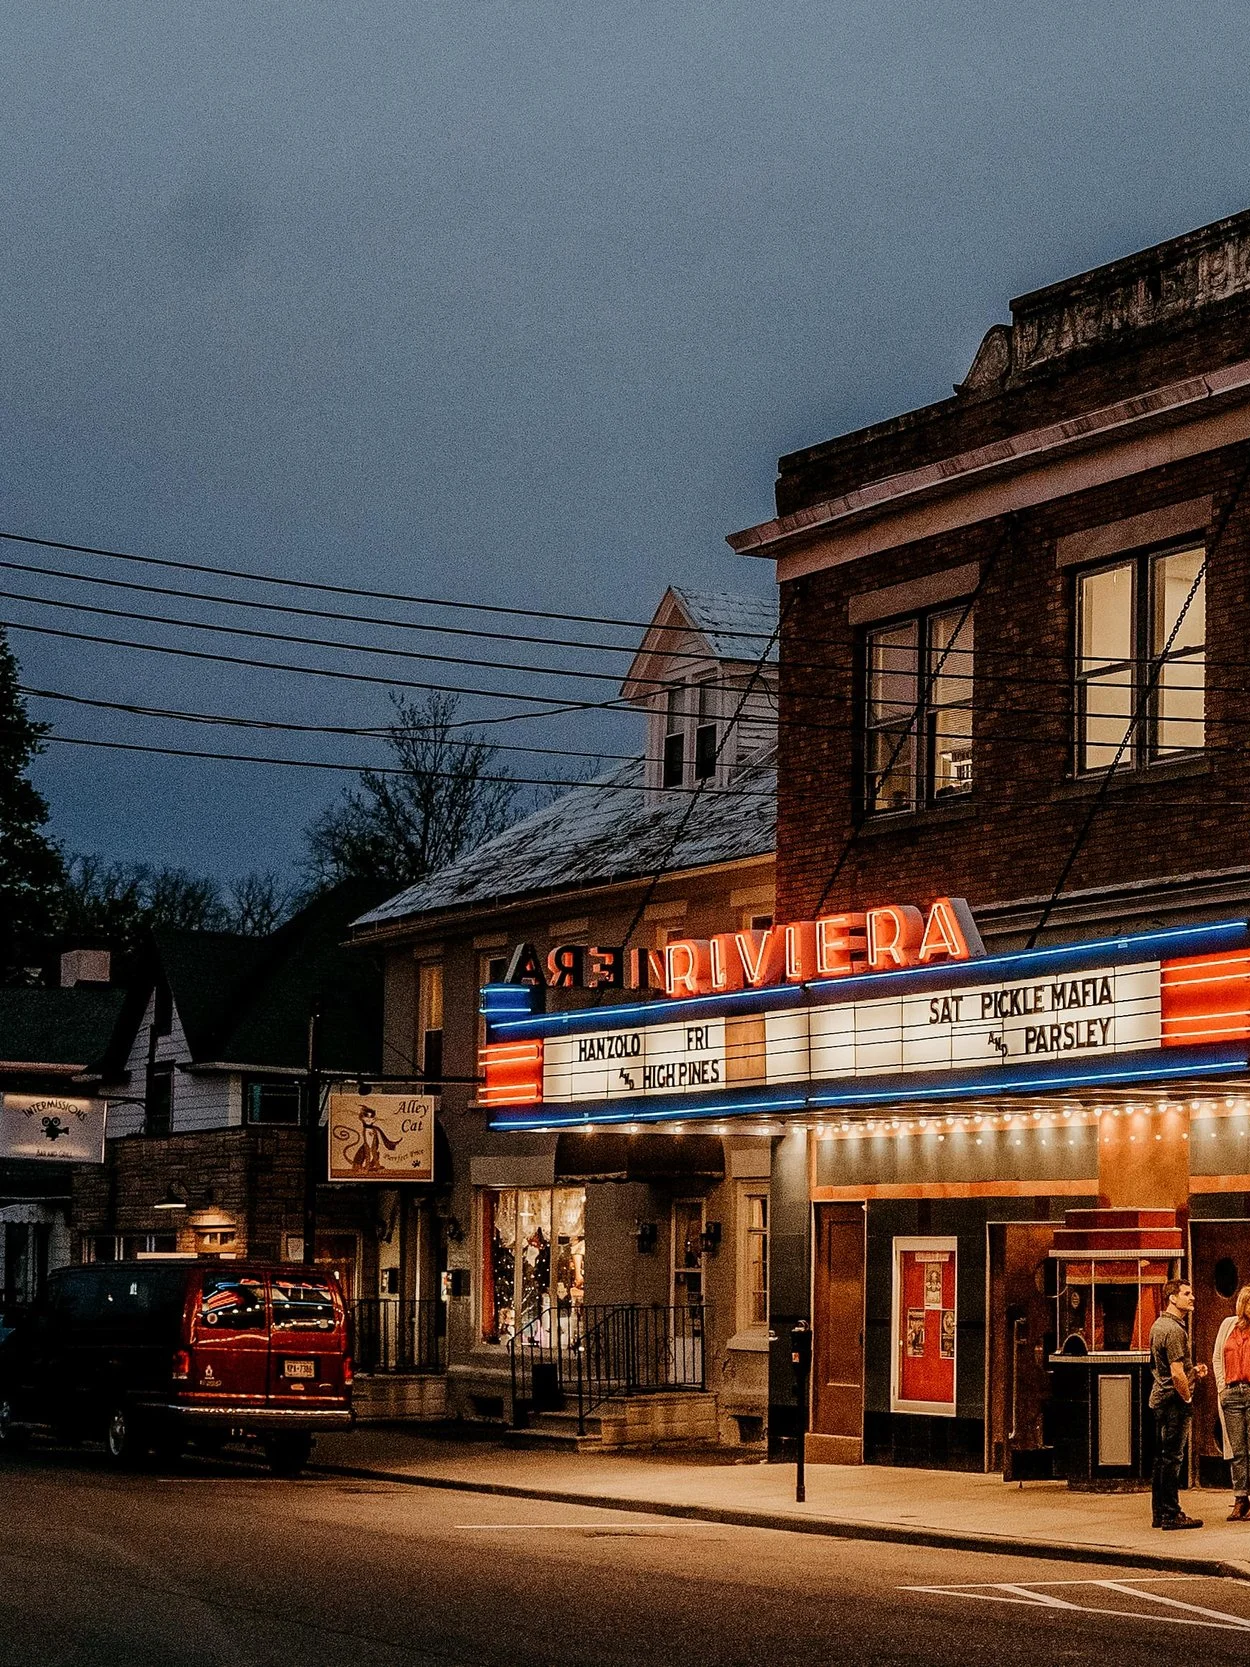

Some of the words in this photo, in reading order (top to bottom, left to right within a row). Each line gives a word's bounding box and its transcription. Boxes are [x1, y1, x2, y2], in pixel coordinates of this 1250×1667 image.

[665, 897, 985, 997] RIVIERA
[929, 995, 963, 1024] SAT
[981, 985, 1045, 1019] PICKLE
[1051, 976, 1113, 1011] MAFIA
[578, 1033, 641, 1062] HANZOLO
[687, 1025, 709, 1050] FRI
[987, 1030, 1009, 1057] AND
[1024, 1017, 1112, 1055] PARSLEY
[619, 1067, 634, 1090] AND
[642, 1063, 675, 1089] HIGH
[678, 1059, 720, 1086] PINES
[394, 1100, 429, 1118] Alley
[401, 1119, 423, 1133] Cat
